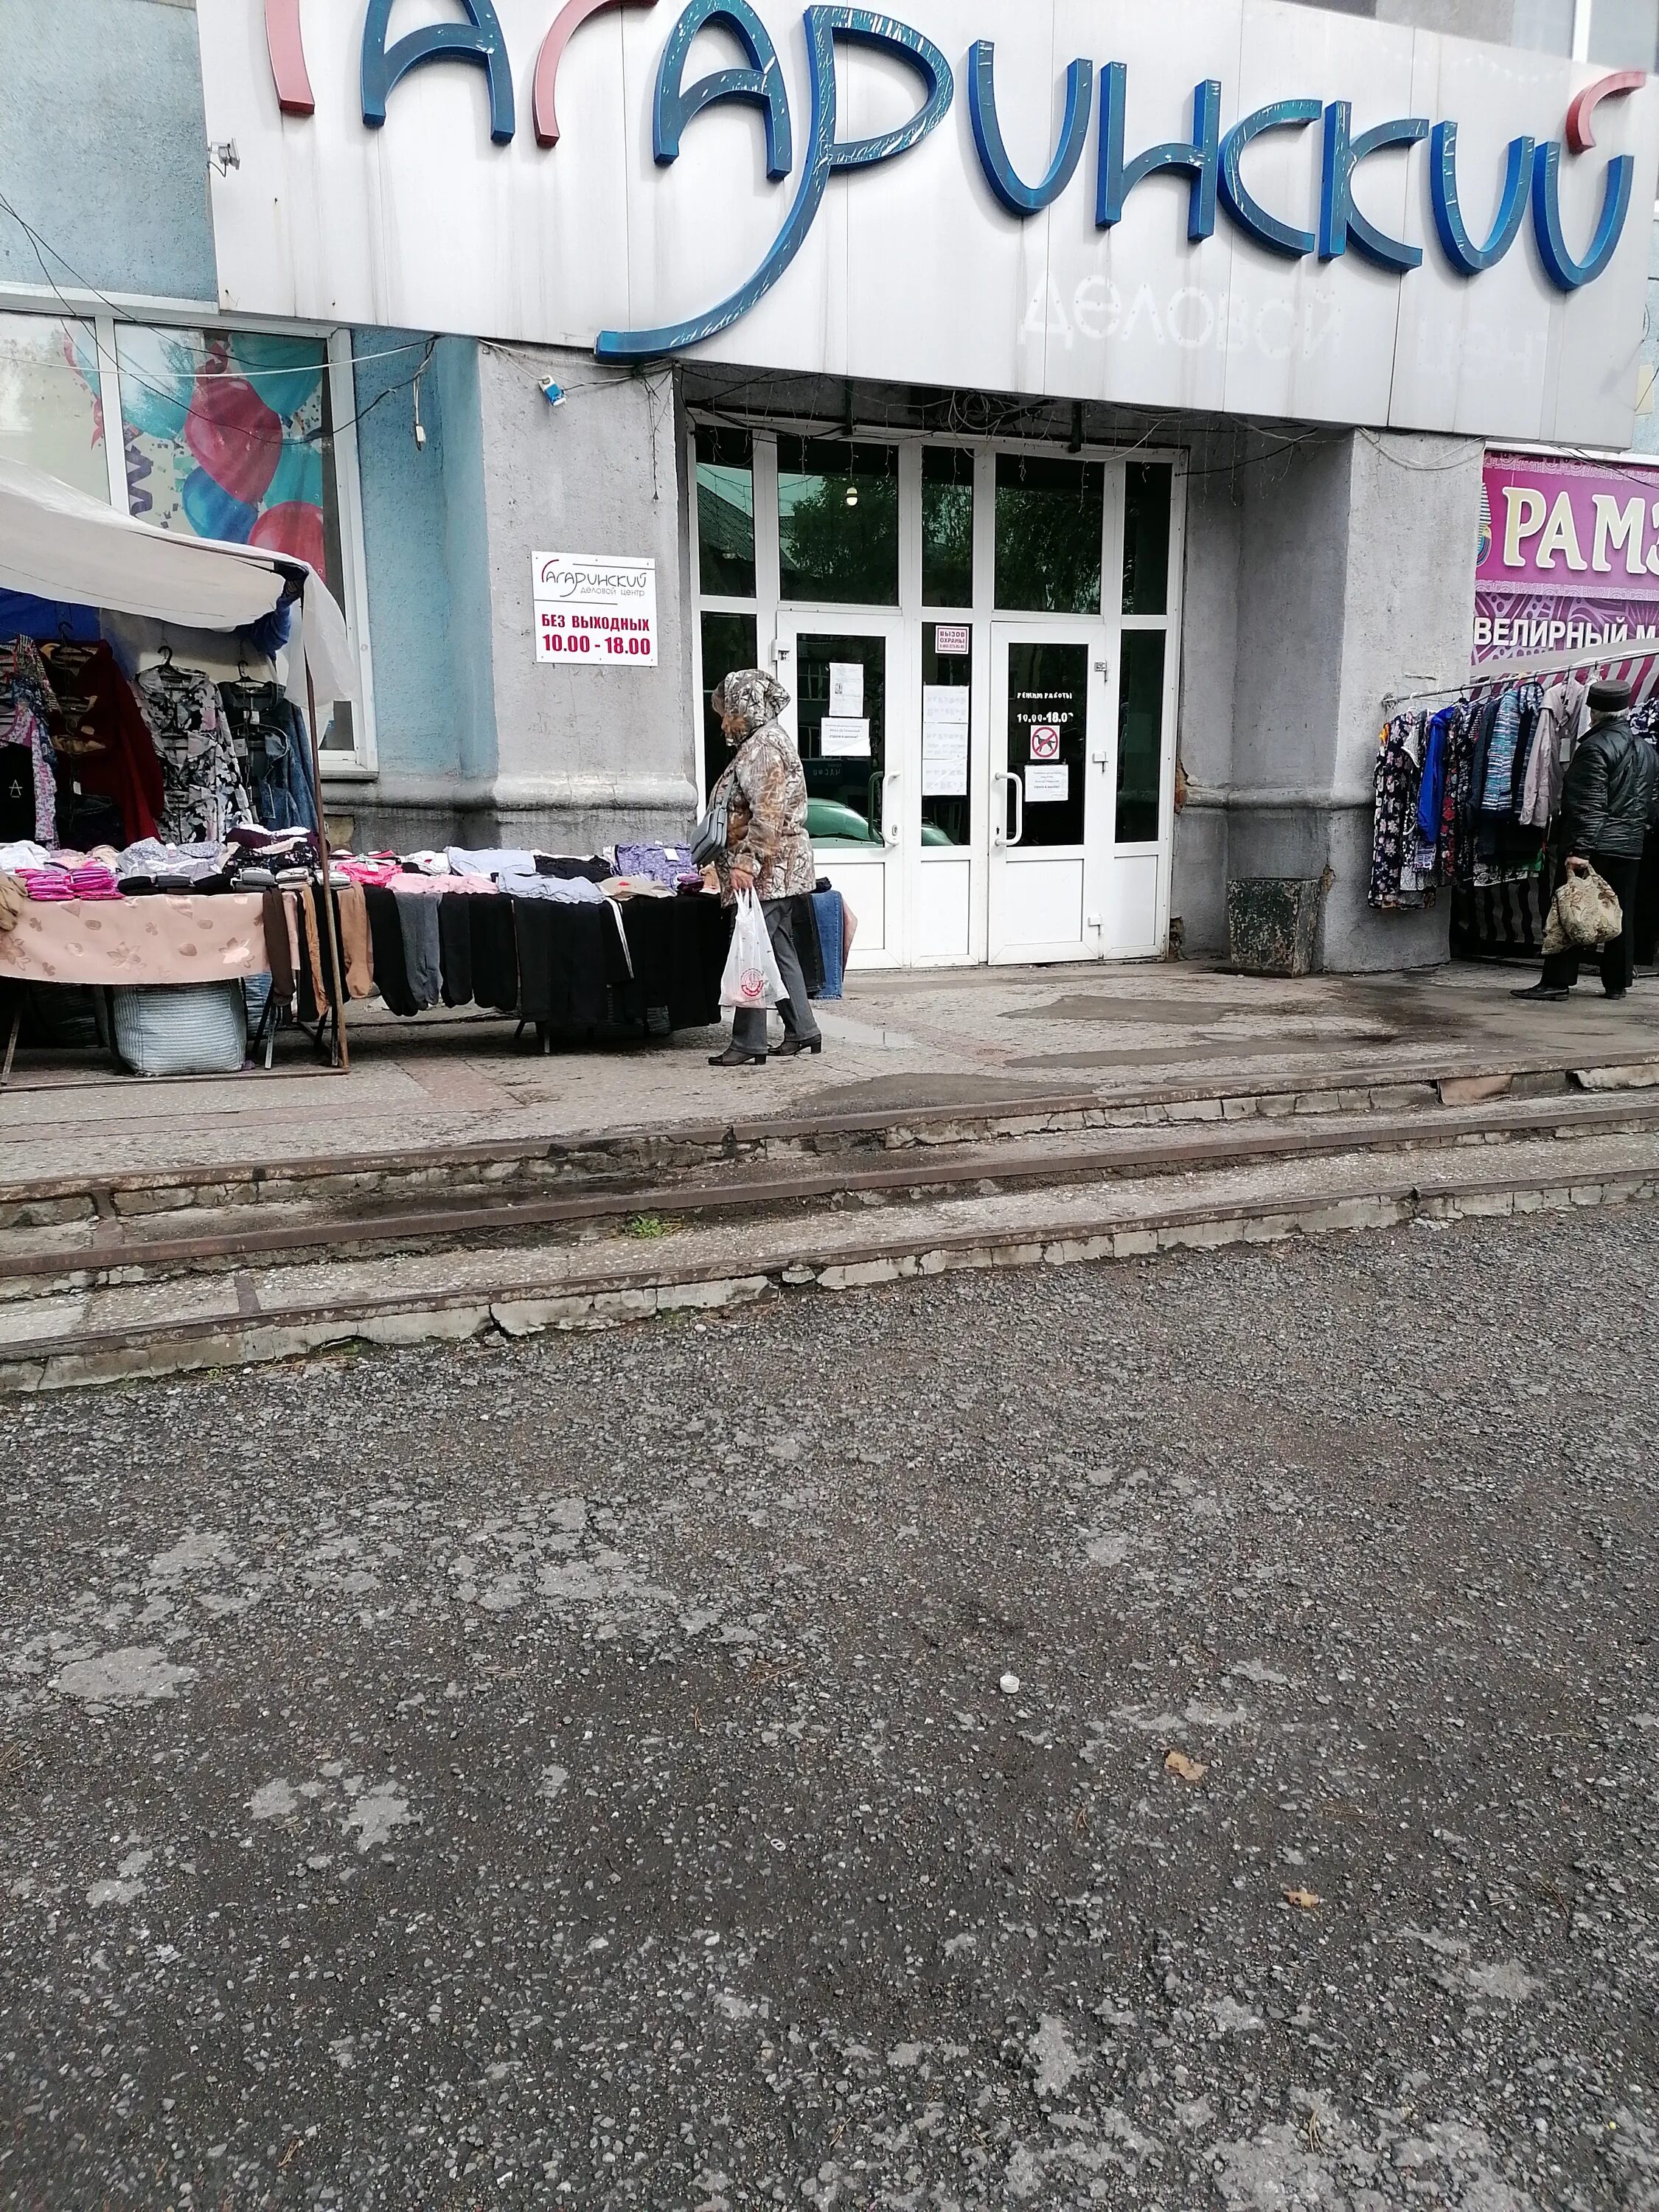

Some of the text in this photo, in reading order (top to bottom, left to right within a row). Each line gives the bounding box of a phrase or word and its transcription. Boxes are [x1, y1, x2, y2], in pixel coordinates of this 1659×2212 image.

[542, 613, 650, 632] БЕЗ ВЫХОДНЫХ
[1475, 616, 1628, 649] ВЕЛИРНЫЙ
[543, 634, 590, 653] 10.00
[605, 636, 650, 655] 18.00
